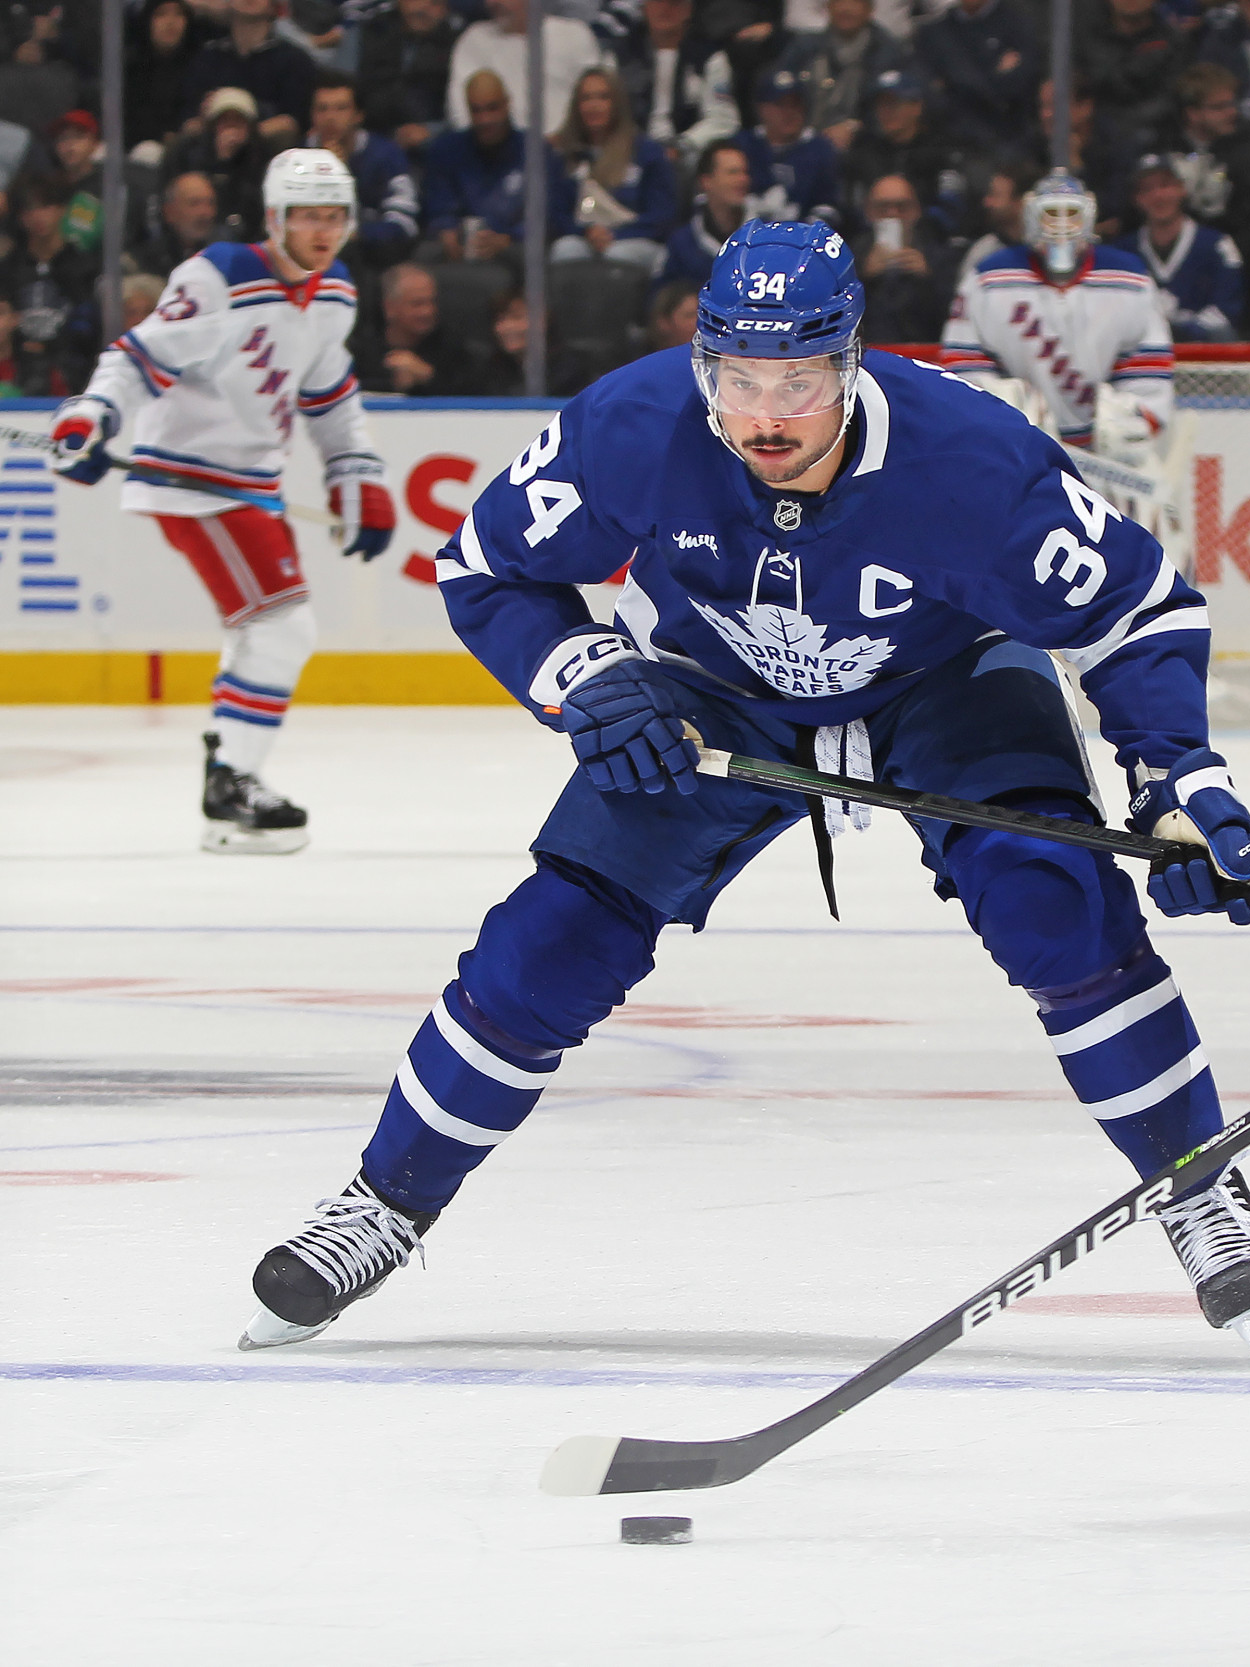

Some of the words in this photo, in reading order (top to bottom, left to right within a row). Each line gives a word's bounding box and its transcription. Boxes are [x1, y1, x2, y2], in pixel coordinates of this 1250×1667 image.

[748, 272, 787, 301] 34
[735, 319, 794, 332] CCM
[1033, 469, 1123, 607] 34
[859, 564, 913, 619] C
[731, 640, 859, 672] TORONTO
[754, 658, 839, 684] MAPLE
[759, 669, 844, 695] LEAFS
[1131, 787, 1151, 812] CCM
[1174, 1116, 1246, 1169] HYPERLITE
[961, 1176, 1174, 1336] BAUER
